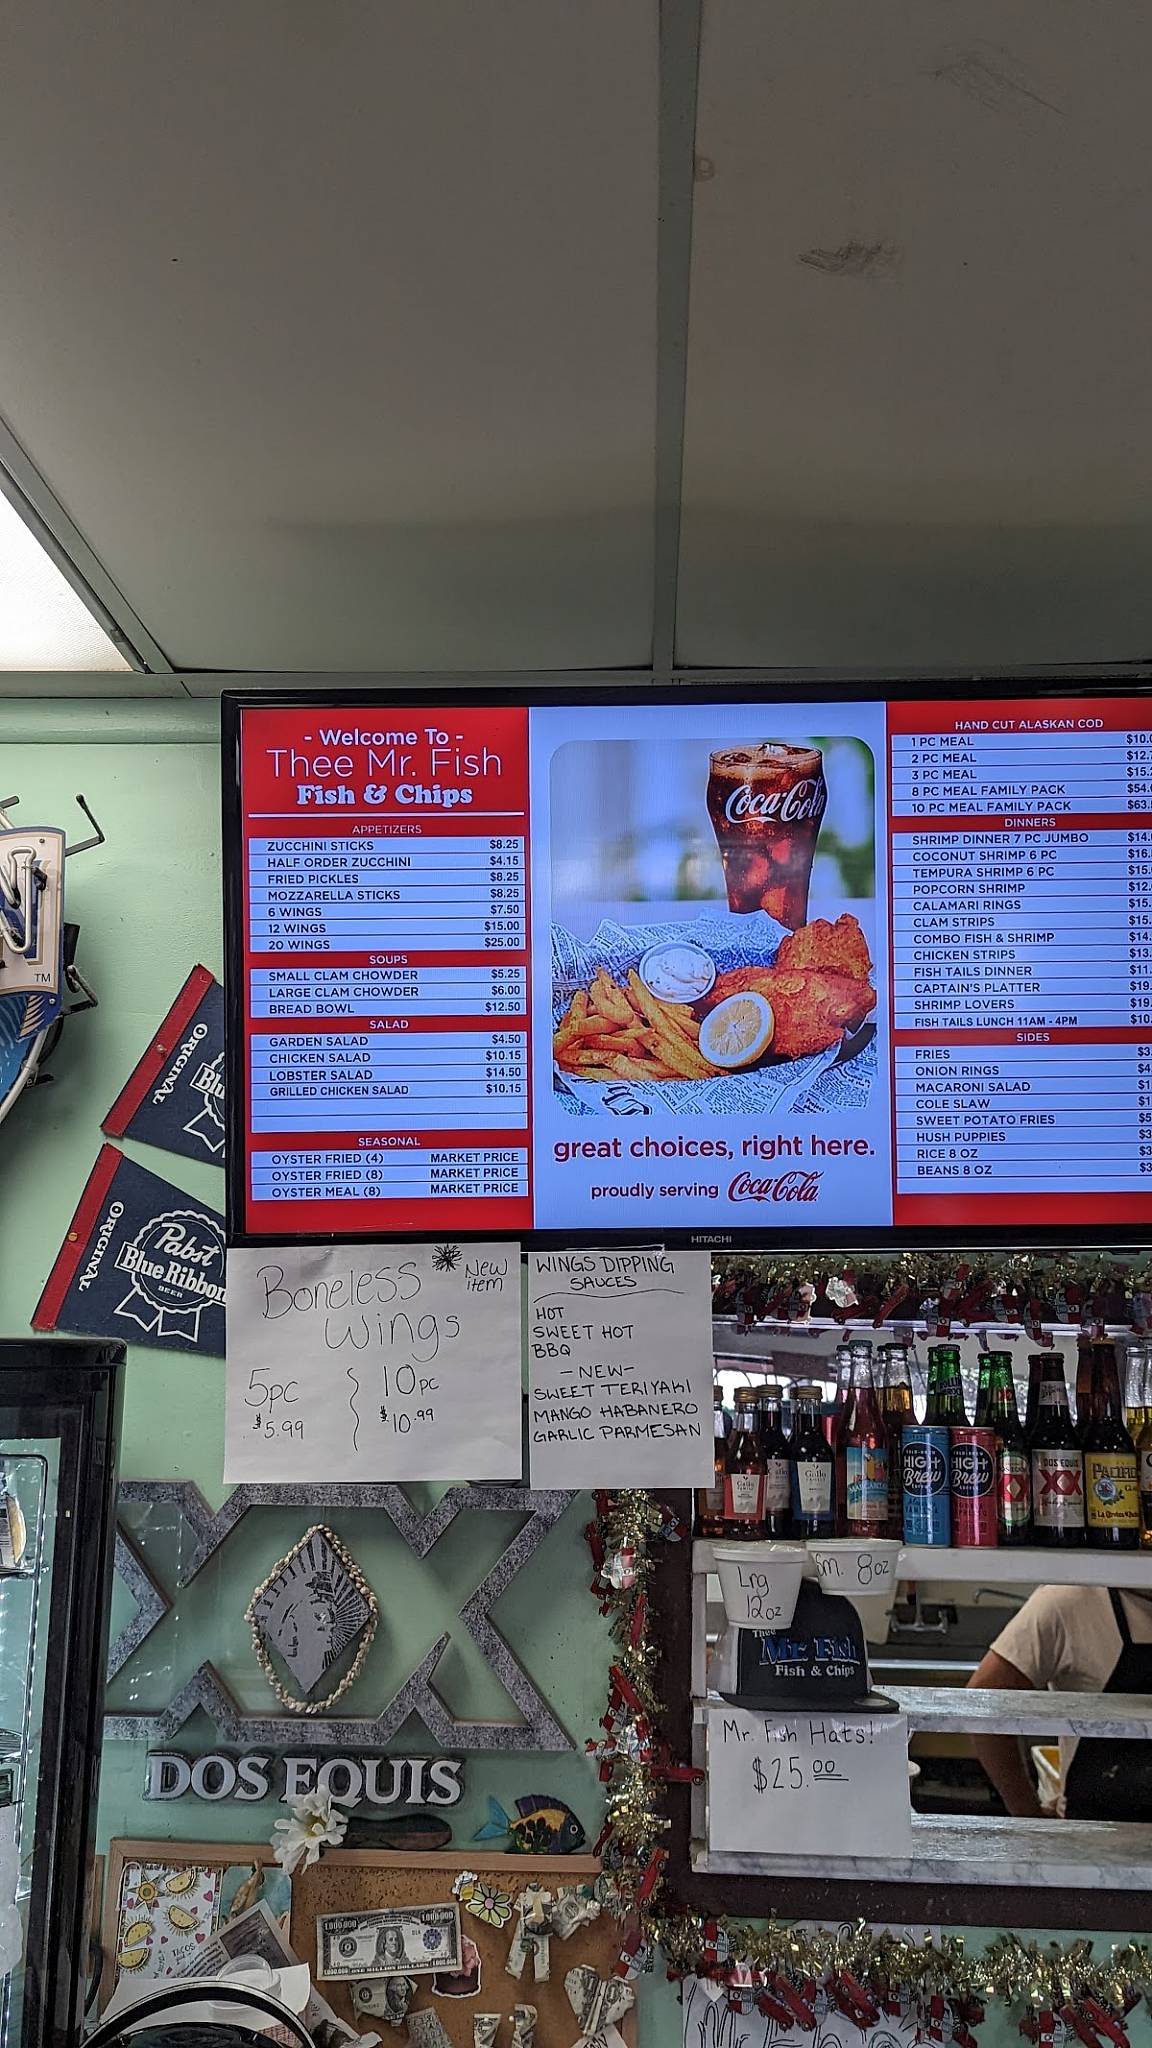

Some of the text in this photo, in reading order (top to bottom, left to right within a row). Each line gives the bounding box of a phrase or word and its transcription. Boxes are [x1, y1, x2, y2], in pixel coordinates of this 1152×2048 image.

[956, 719, 1103, 730] HAND CUT ALASKAN COD
[320, 728, 448, 745] Welcome To
[267, 747, 500, 776] Thee Mr. Fish
[912, 754, 976, 763] 2 PC MEAL
[297, 784, 472, 807] Fish & Chips
[912, 785, 1065, 796] 8 PC MEAL FAMILY PACK
[1005, 818, 1055, 827] DINNERS
[352, 825, 421, 834] APPETIZERS
[268, 841, 374, 851] ZUCCHINI STICKS
[490, 840, 518, 849] $8.25
[268, 857, 410, 867] HALF ORDER ZUCCHINI
[490, 856, 518, 866] $4.15
[268, 891, 400, 900] MOZZARELLA STICKS
[490, 889, 519, 898] $8.25
[914, 900, 1020, 910] CALAMARI RINGS
[485, 921, 519, 931] $15.00
[914, 917, 994, 927] CLAM STRIPS
[269, 924, 326, 933] 12 WINGS
[370, 955, 407, 964] SOUPS
[914, 949, 1016, 960] CHICKEN STRIPS
[269, 971, 417, 981] SMALL CLAM CHOWDER
[492, 969, 520, 979] $5.25
[915, 966, 1032, 976] FISH TAILS DINNER
[34, 972, 52, 983] TM
[914, 983, 1040, 993] CAPTAIN'S PLATTER
[270, 1004, 354, 1014] BREAD BOWL
[486, 1002, 520, 1012] $12.50
[370, 1020, 408, 1028] SALAD
[270, 1037, 368, 1046] GARDEN SALAD
[492, 1034, 520, 1044] $4.50
[1017, 1033, 1049, 1041] SIDES
[916, 1050, 950, 1059] FRIES
[152, 1023, 208, 1104] ORIGINAL
[270, 1070, 372, 1081] LOBSTER SALAD
[486, 1067, 520, 1078] $14.50
[916, 1066, 999, 1076] ONION RINGS
[270, 1086, 408, 1096] GRILLED CHICKEN SALAD
[486, 1084, 521, 1094] $10.15
[916, 1081, 1031, 1092] MACARONI SALAD
[917, 1115, 1054, 1125] SWEET POTATO FRIES
[359, 1137, 420, 1146] SEASONAL
[917, 1132, 1005, 1142] HUSH PUPPIES
[554, 1135, 874, 1162] great choices, right here.
[272, 1154, 383, 1164] OYSTER FRIED (4)
[431, 1153, 521, 1164] MARKET PRICE
[592, 1171, 824, 1202] proudly serving Coca-Cola
[78, 1201, 124, 1291] ORIGINAL
[154, 1222, 220, 1267] Pabst
[536, 1255, 675, 1274] WINGS DIPPING
[120, 1246, 226, 1302] Blue Ribbon
[466, 1275, 504, 1292] item
[570, 1275, 637, 1291] SAUCES
[158, 1285, 183, 1299] BEER
[256, 1261, 421, 1319] Boneless
[535, 1306, 565, 1320] HOT
[325, 1312, 460, 1363] Wings
[532, 1324, 634, 1340] SWEET HOT
[531, 1342, 571, 1359] BBQ
[534, 1379, 692, 1401] SWEET TERIYAKI
[533, 1402, 698, 1424] MANGO HABANERO
[533, 1422, 701, 1443] GARLIC PARMESAN
[904, 1456, 941, 1469] HIGH
[903, 1468, 942, 1486] Brew
[814, 1636, 861, 1665] Fish
[775, 1664, 856, 1678] Fish & Chips
[764, 1719, 798, 1743] Fish
[810, 1718, 875, 1746] Hats!
[147, 1753, 465, 1808] DOS EQUIS
